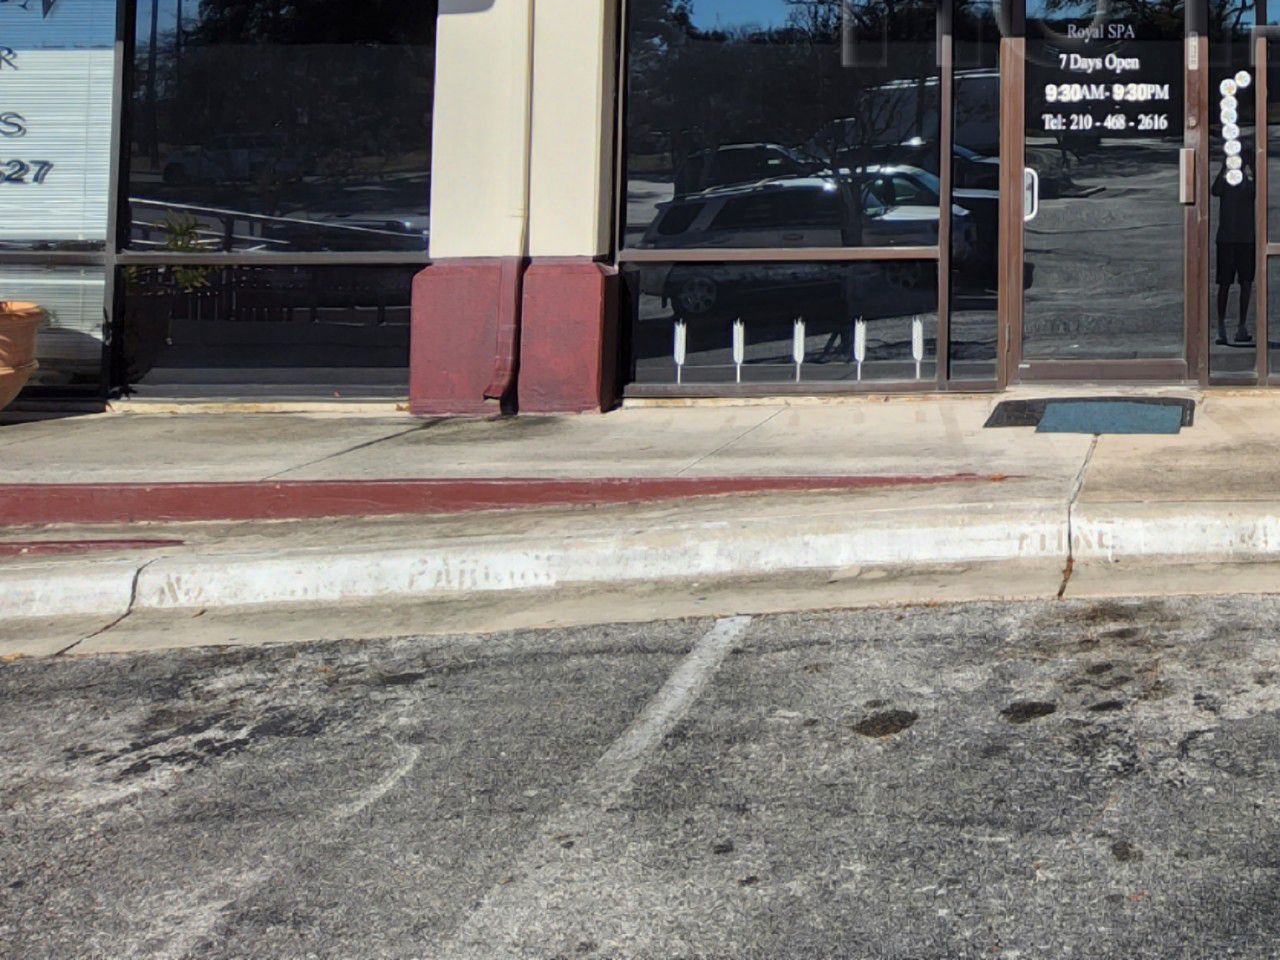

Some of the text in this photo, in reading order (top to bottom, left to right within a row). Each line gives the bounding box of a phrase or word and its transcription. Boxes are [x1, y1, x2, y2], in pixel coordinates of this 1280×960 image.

[1067, 24, 1136, 43] Royal SPA
[1059, 53, 1140, 74] 7 Days Open
[1041, 113, 1067, 130] Tel:
[1069, 113, 1093, 130] 210
[1103, 113, 1127, 130] 468
[1137, 113, 1168, 130] 2616
